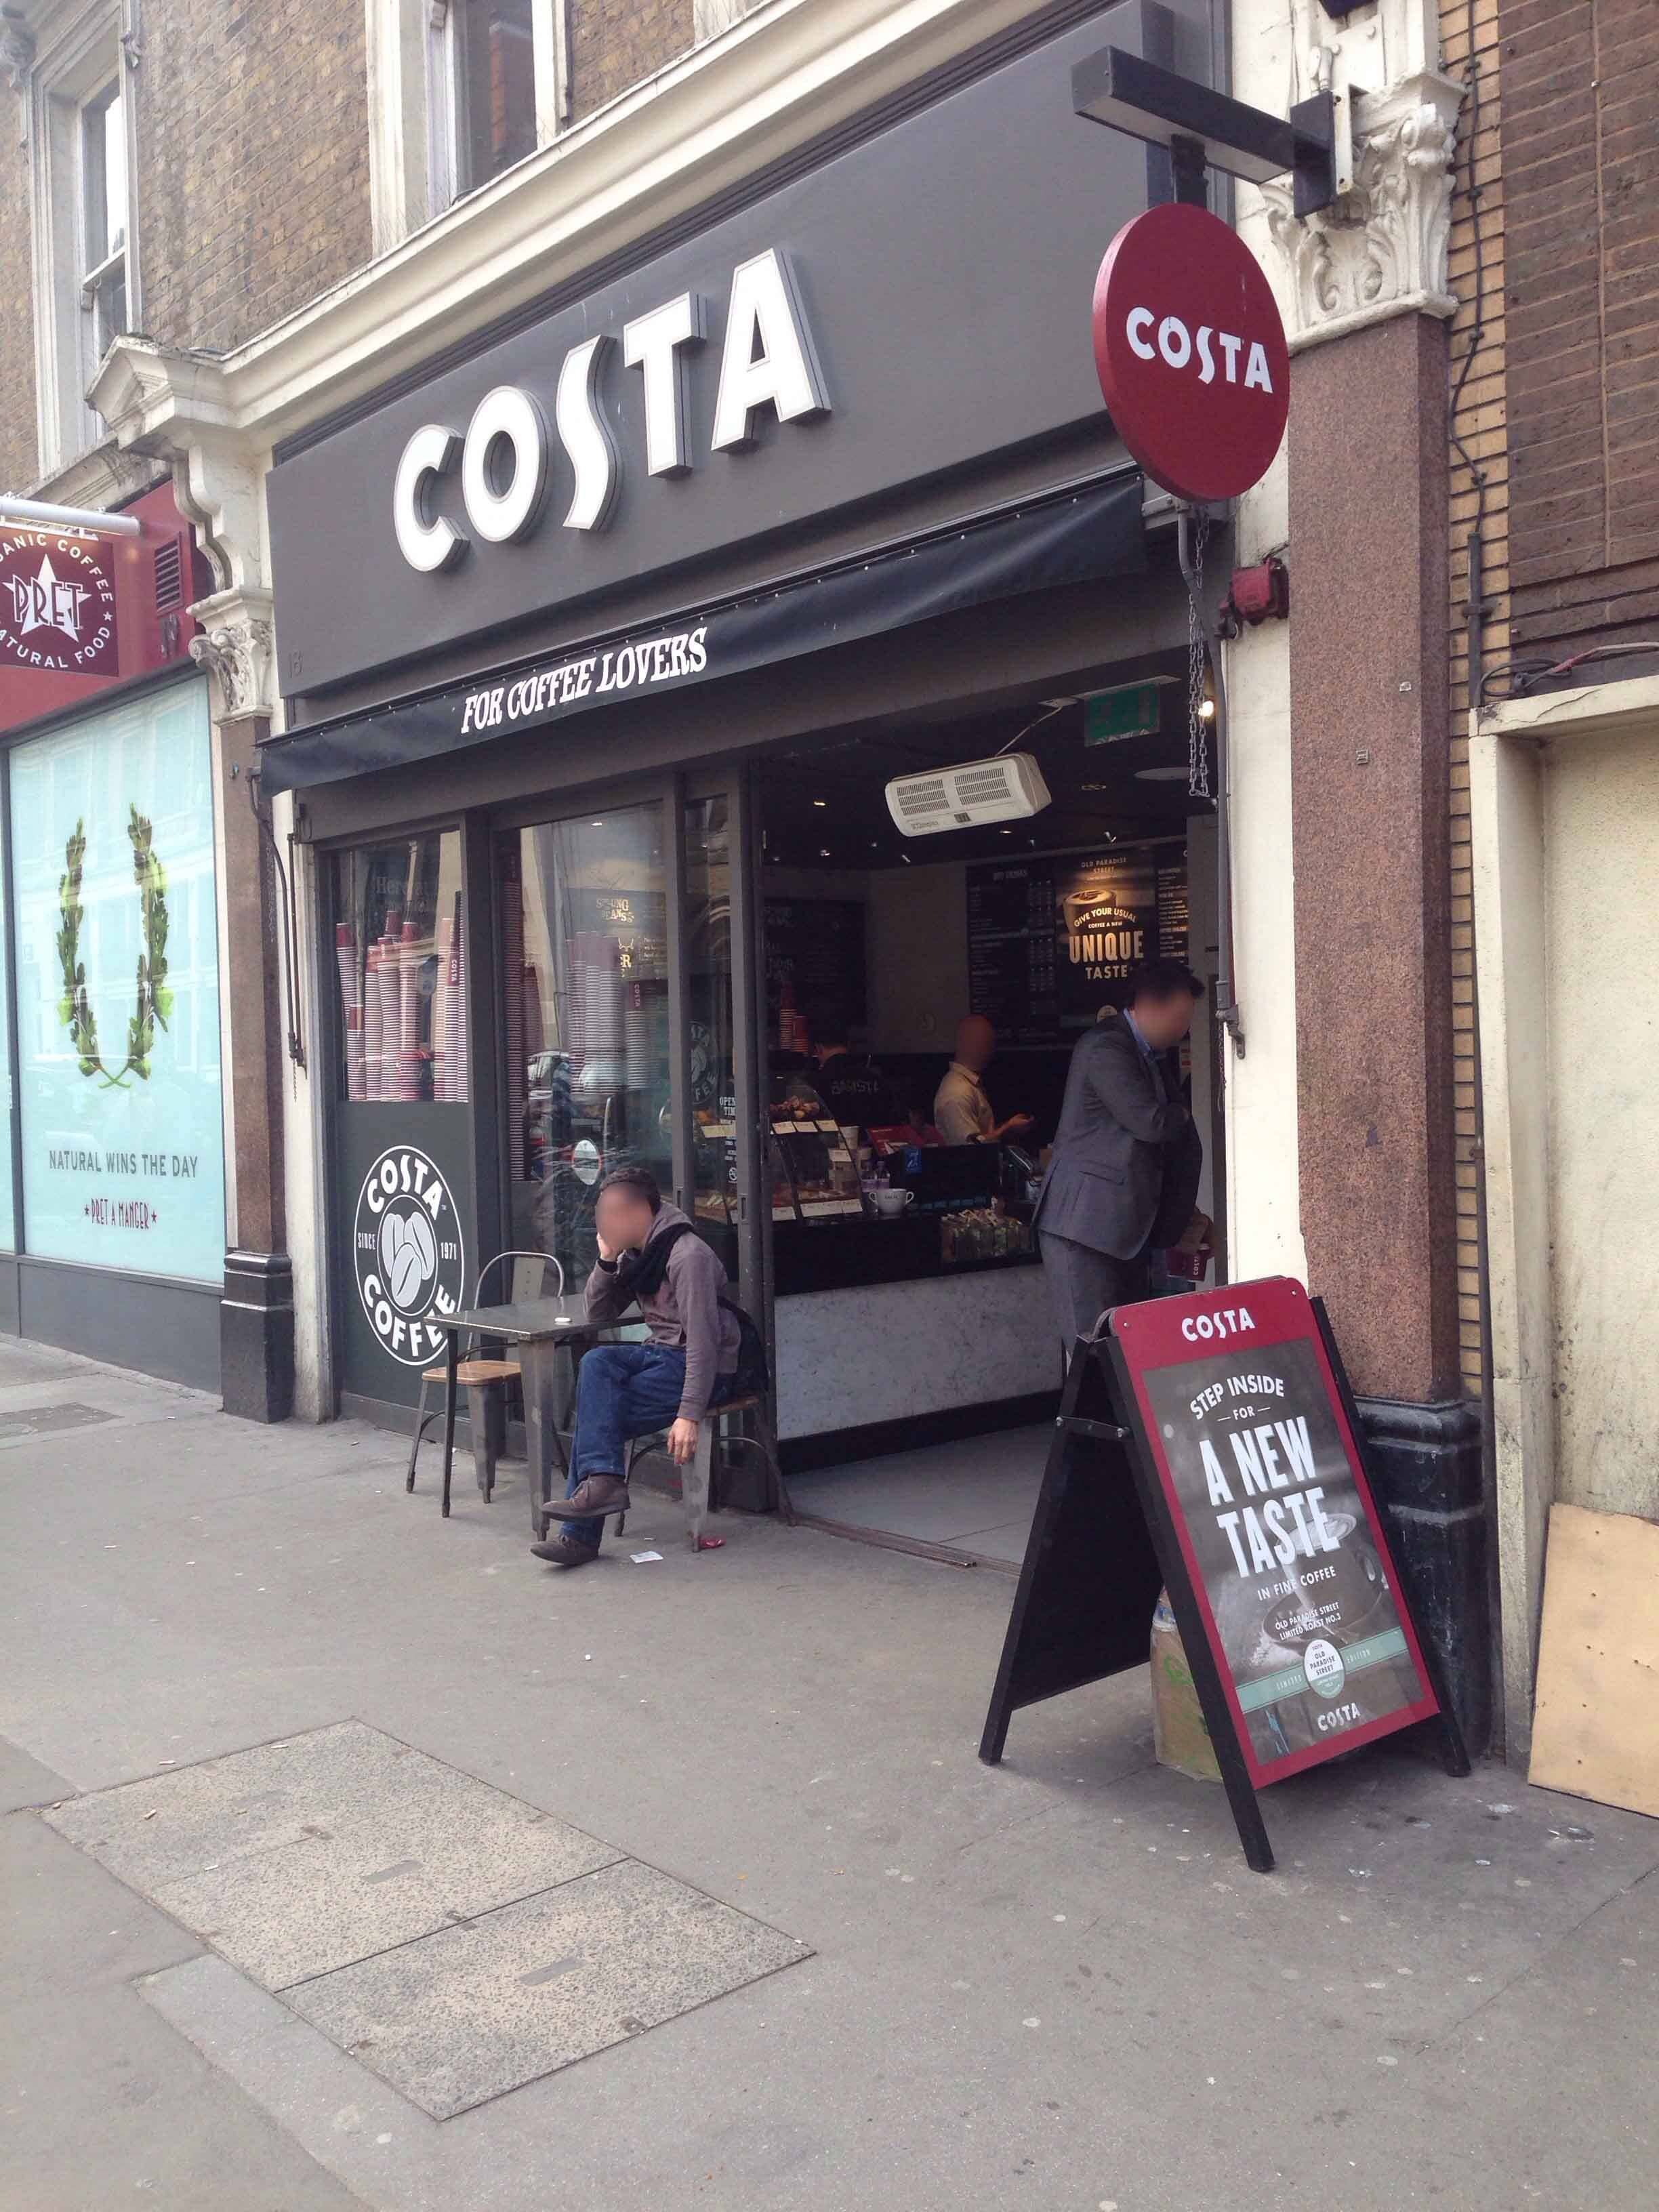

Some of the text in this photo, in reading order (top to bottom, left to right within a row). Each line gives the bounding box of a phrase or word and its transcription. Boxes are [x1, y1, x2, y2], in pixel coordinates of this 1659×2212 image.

[1126, 306, 1273, 394] COSTA
[393, 247, 832, 573] COSTA
[57, 539, 114, 602] COFFEE
[12, 574, 83, 630] PRET
[0, 627, 110, 668] ATURAL FOOD
[461, 626, 708, 733] FOR COFFEE LOVERS
[1073, 907, 1136, 927] GIVE YOUR USUAL
[1069, 930, 1145, 964] UNIQUE
[1085, 964, 1128, 979] TASTE
[49, 1150, 199, 1178] NATURAL WINS THE DAY
[367, 1154, 443, 1220] COSTA
[91, 1198, 150, 1229] PRET A MANGER
[357, 1232, 376, 1250] SINCE
[440, 1242, 457, 1261] 1971
[1181, 1307, 1256, 1342] COSTA
[1190, 1374, 1285, 1420] STEP INSIDE
[1232, 1406, 1255, 1420] FOR
[1199, 1416, 1317, 1507] A NEW
[1216, 1486, 1341, 1578] TASTE
[1257, 1565, 1337, 1601] IN FINE COFFEE
[1275, 1602, 1340, 1630] OLD PARADISE STREET
[1279, 1626, 1304, 1641] LIMITED
[1305, 1618, 1324, 1632] ROAST
[1309, 1656, 1336, 1669] PARADISE
[1314, 1651, 1326, 1659] OLD
[1315, 1664, 1334, 1676] STREET
[1317, 1702, 1361, 1732] COSTA
